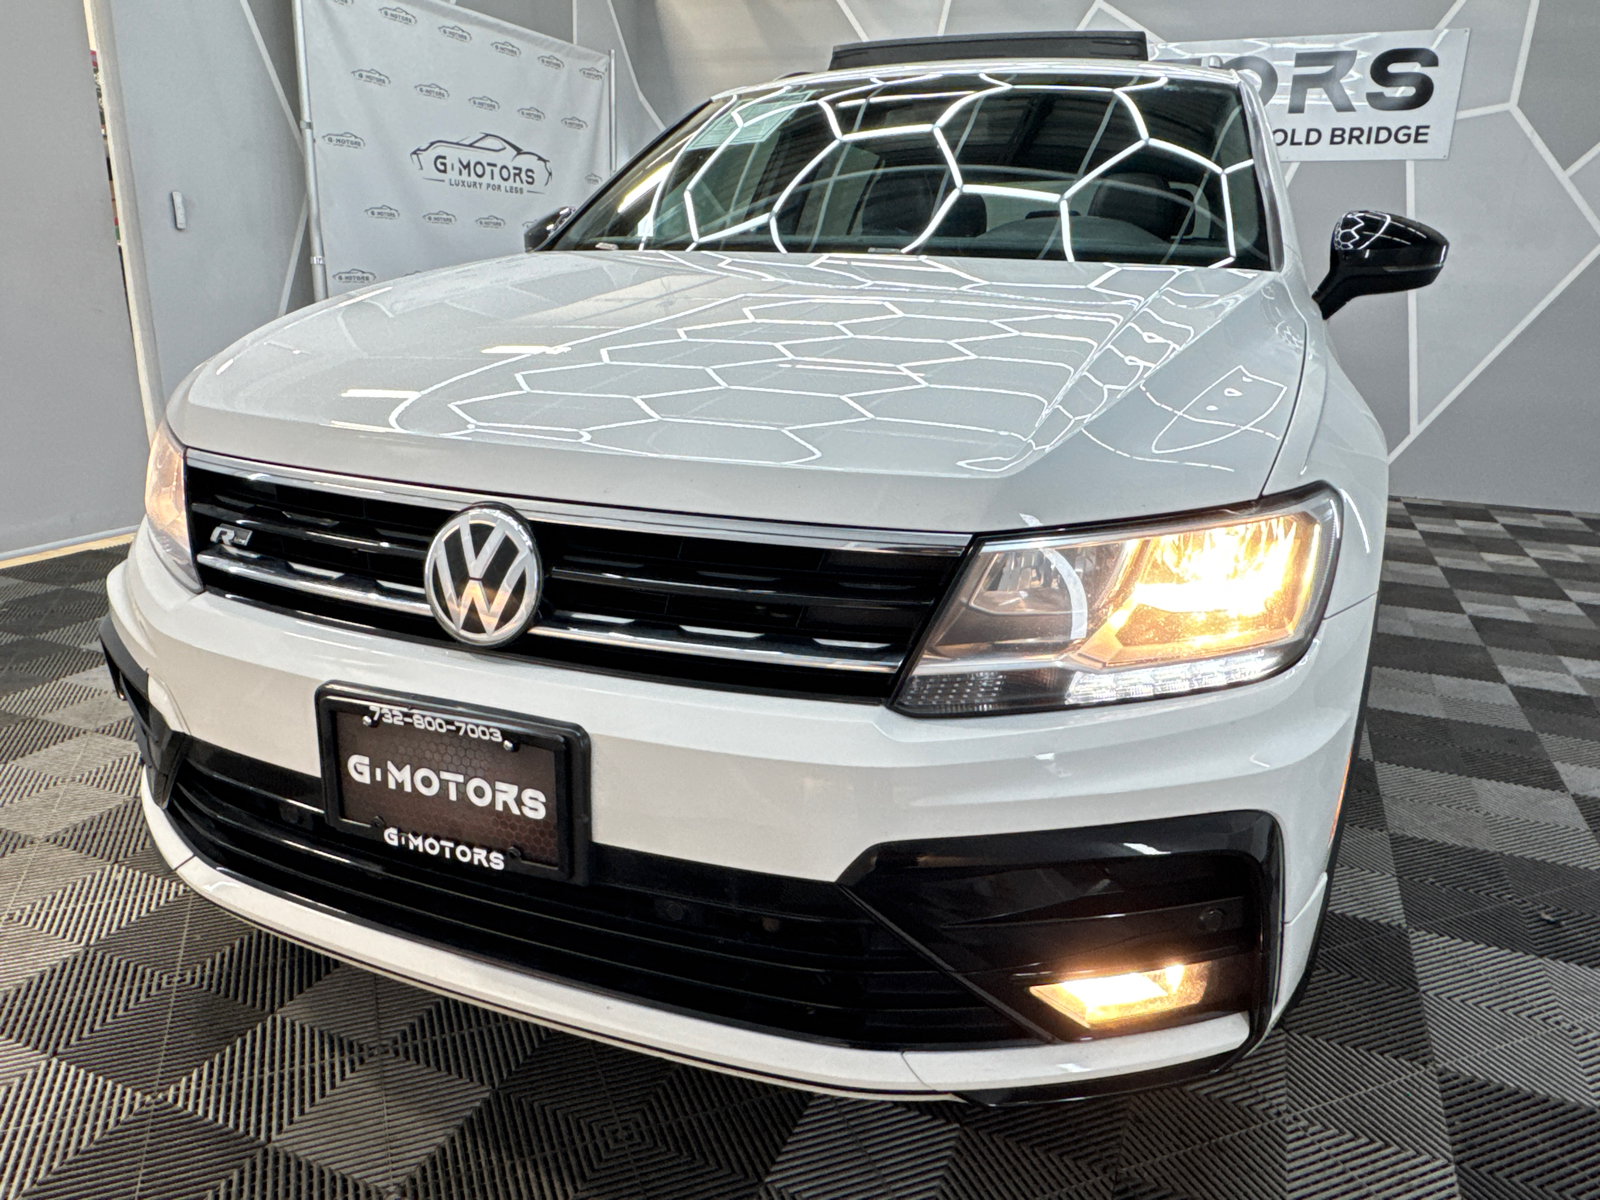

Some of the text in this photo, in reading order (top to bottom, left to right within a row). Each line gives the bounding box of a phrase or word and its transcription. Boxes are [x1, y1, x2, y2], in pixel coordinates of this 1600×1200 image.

[1272, 125, 1430, 146] OLD BRIDGE
[449, 178, 483, 189] LUXURY
[504, 186, 524, 195] LESS
[369, 705, 503, 743] 732-800-7003
